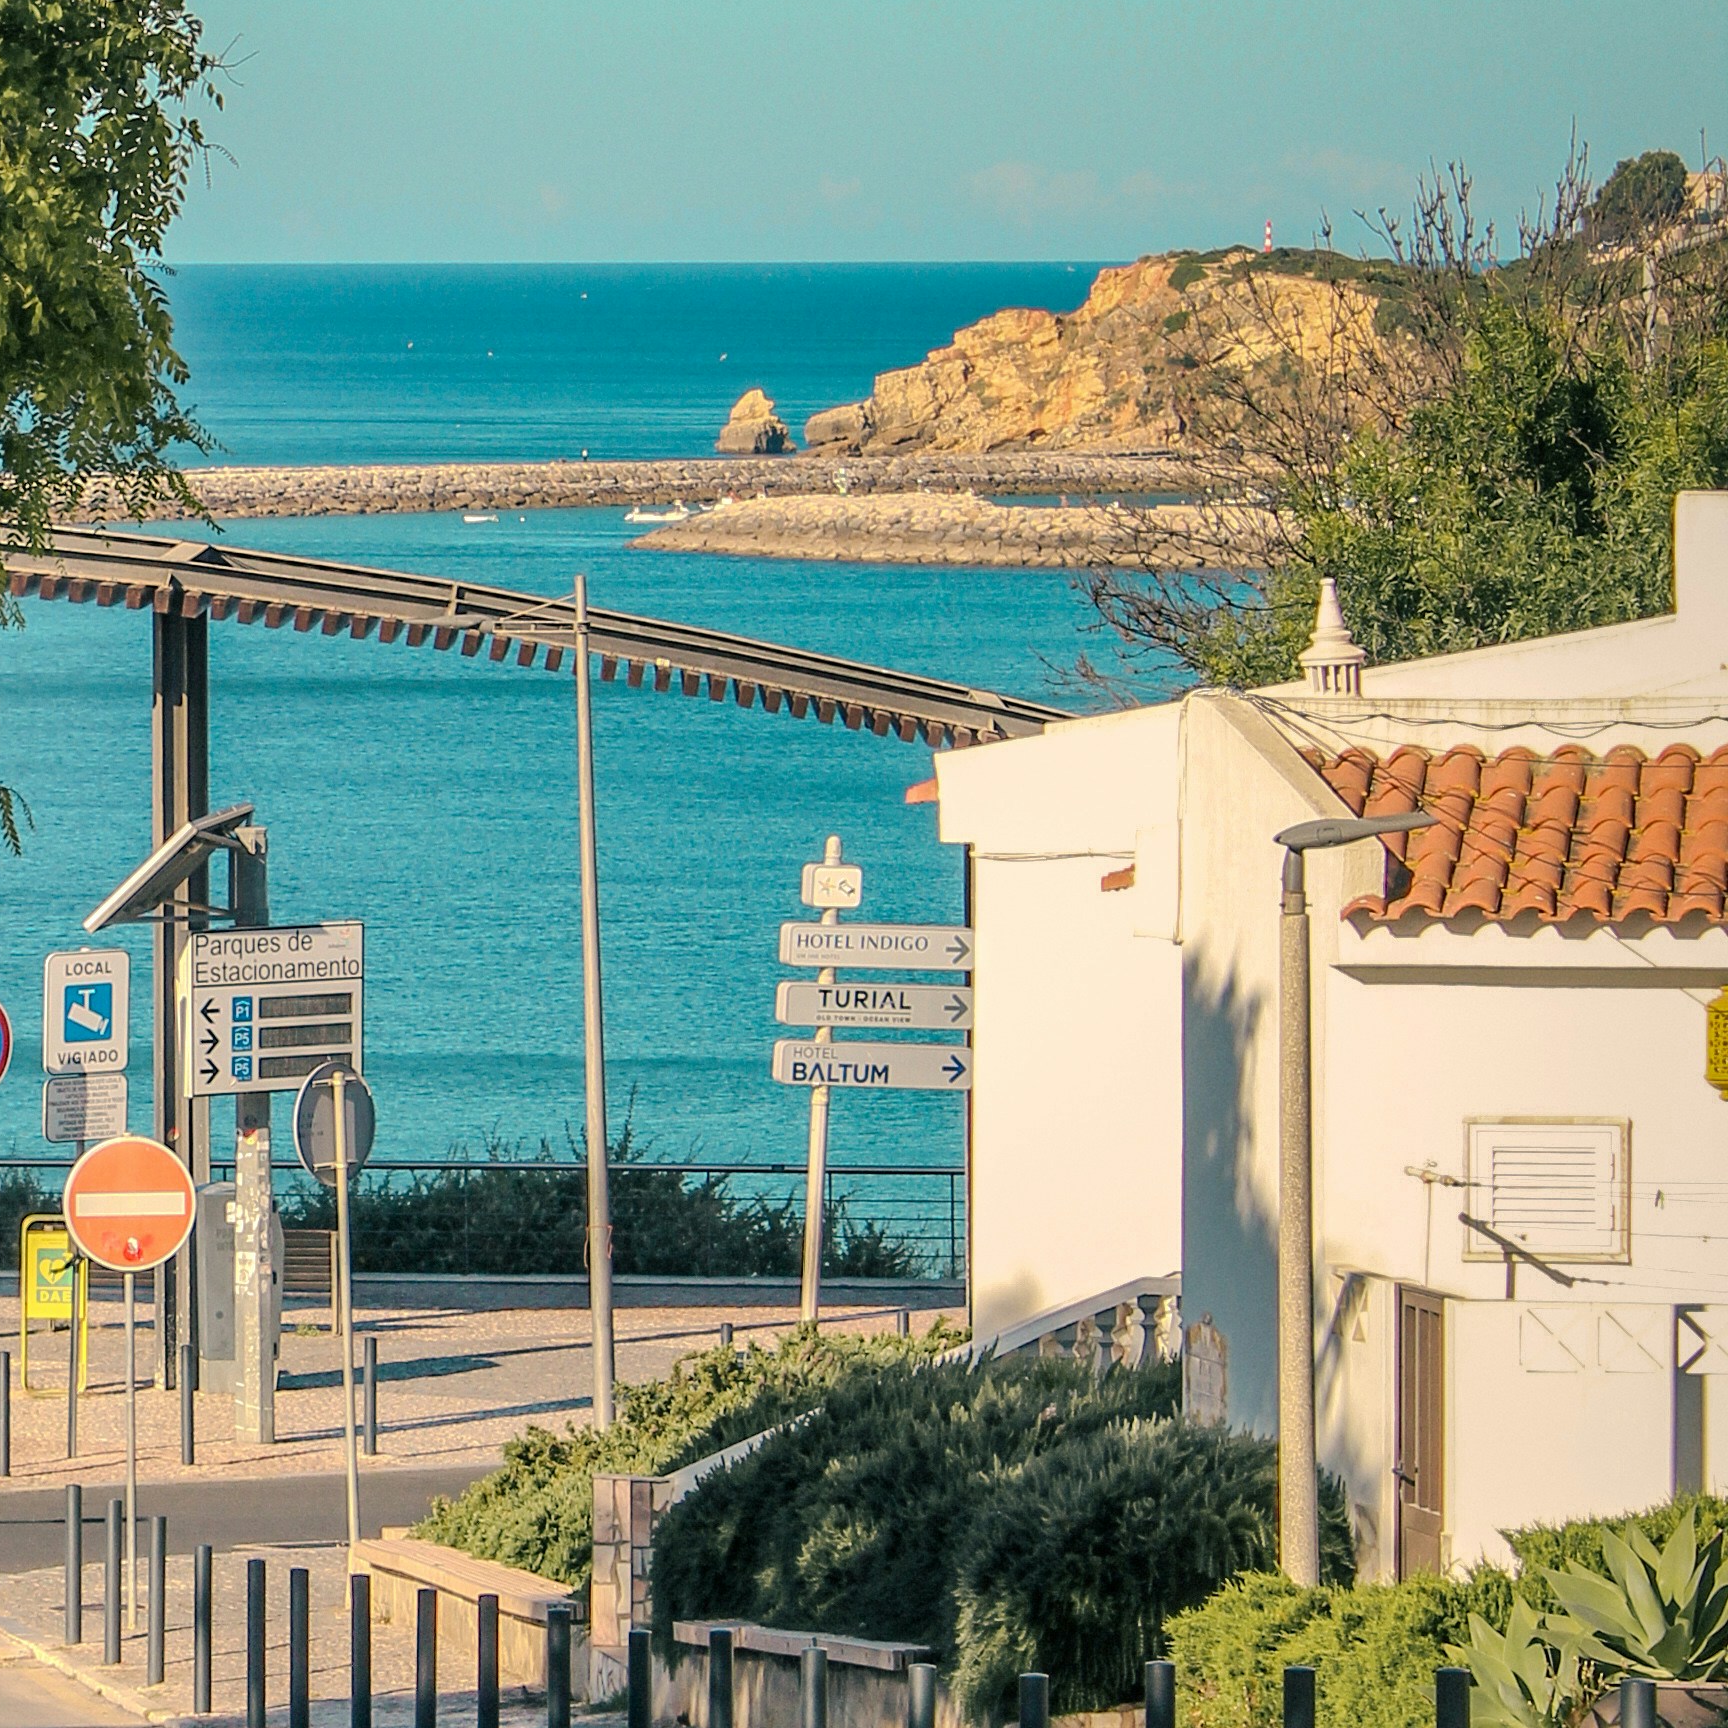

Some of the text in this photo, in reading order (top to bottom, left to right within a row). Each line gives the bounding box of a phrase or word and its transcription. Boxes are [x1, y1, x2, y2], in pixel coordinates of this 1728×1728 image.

[195, 929, 313, 959] Parques de
[797, 934, 929, 952] HOTEL INDIGO
[65, 961, 112, 976] LOCAL
[195, 956, 360, 983] Estacionamento
[818, 990, 912, 1010] TURIAL
[235, 1006, 250, 1018] P1
[863, 1015, 889, 1023] OCEAN
[234, 1032, 250, 1046] P5
[57, 1049, 119, 1065] VIGIADO
[793, 1046, 838, 1059] HOTEL
[234, 1062, 250, 1076] P5
[792, 1062, 890, 1084] BALTUM
[39, 1290, 72, 1302] DAE
